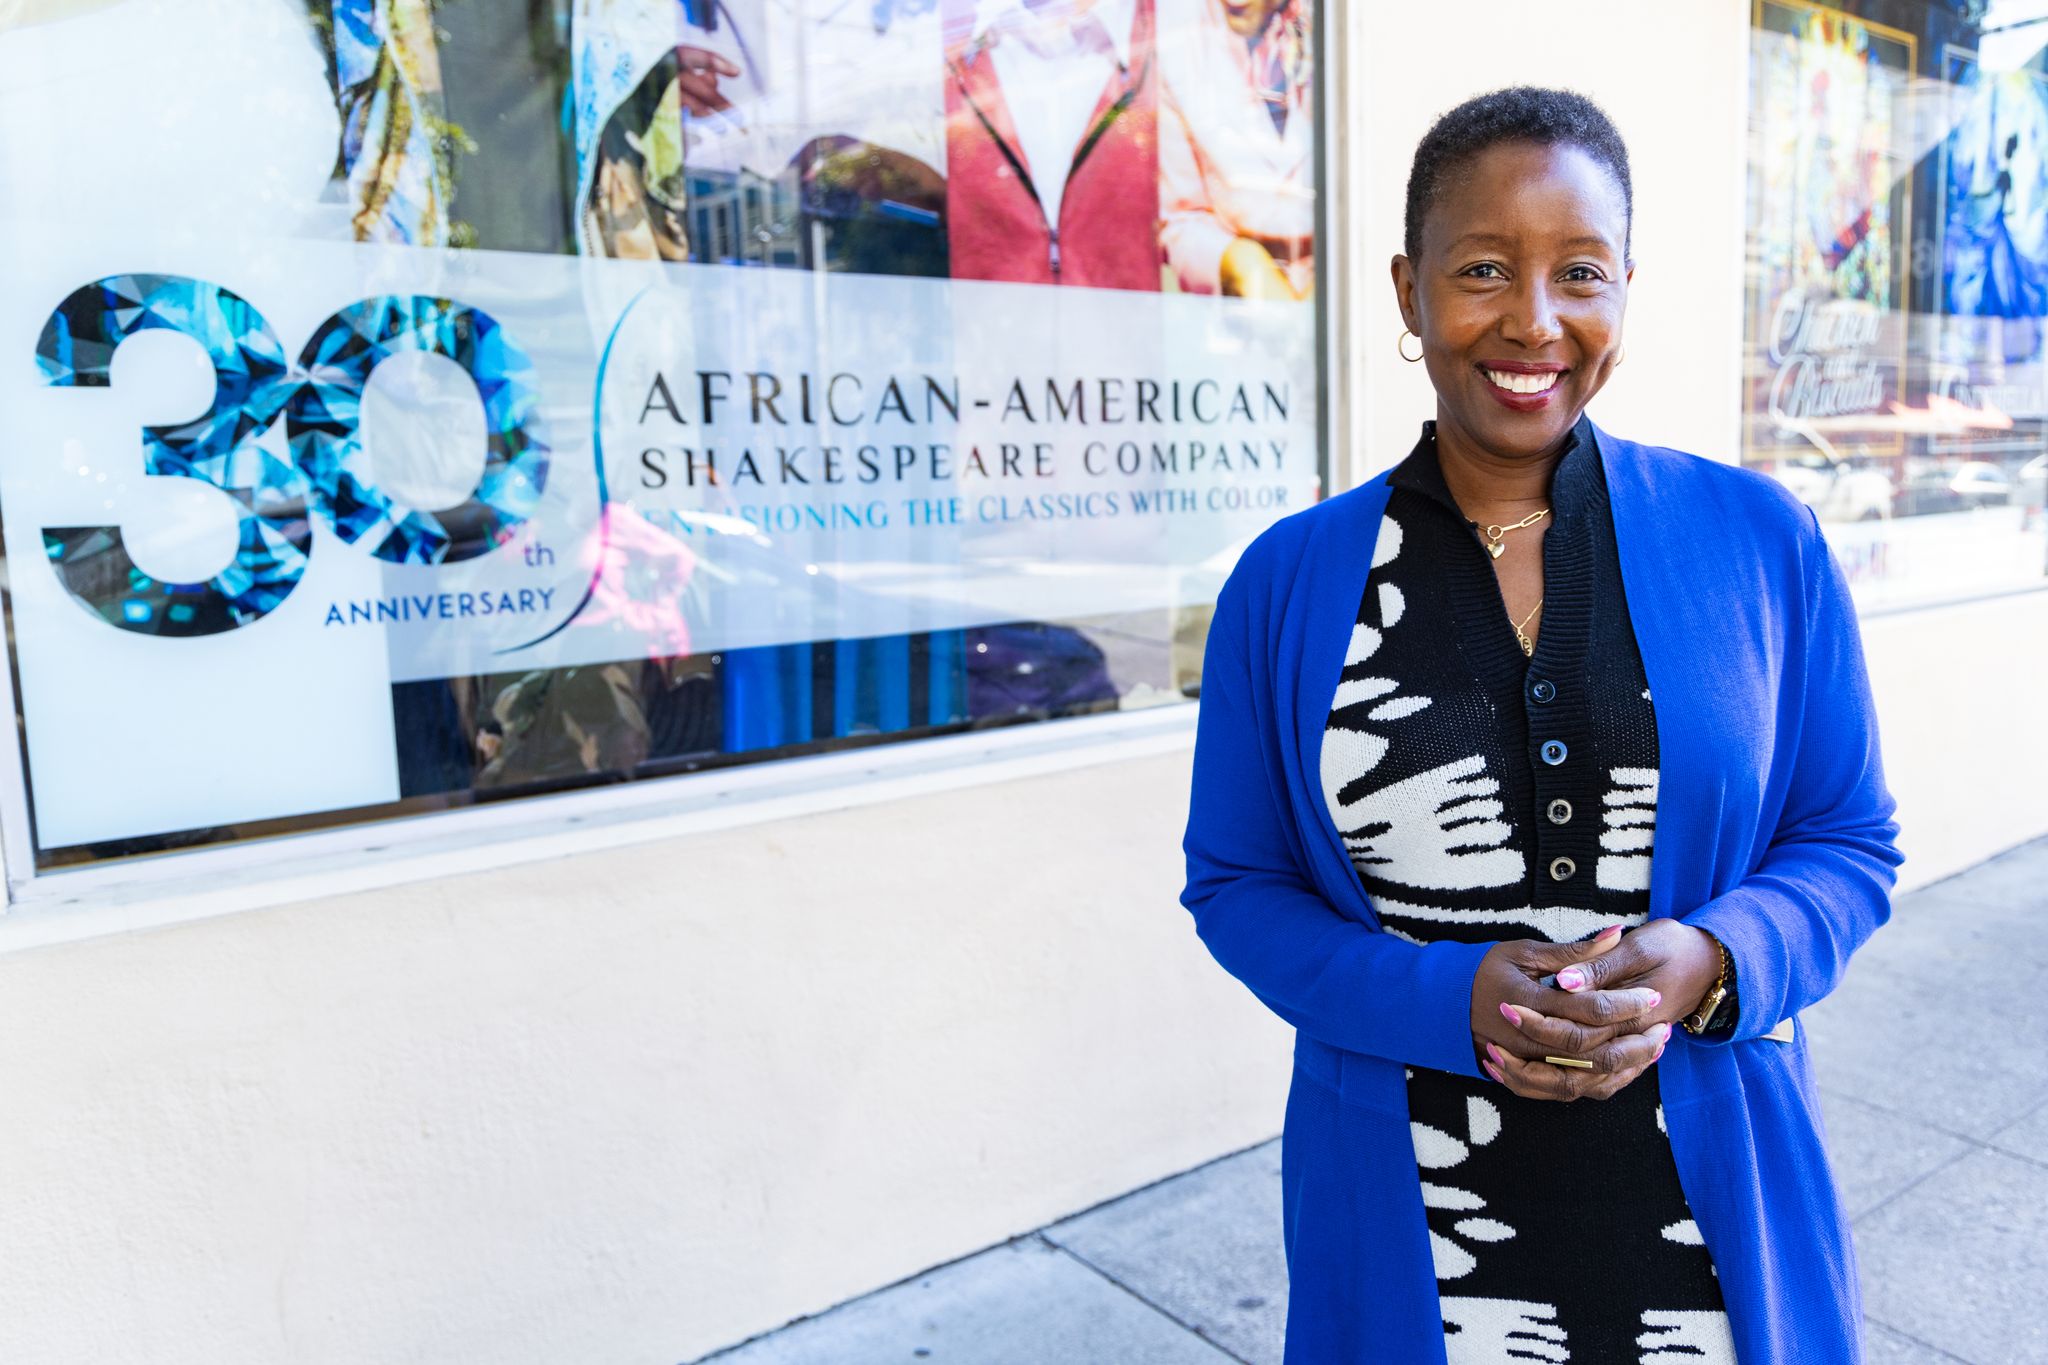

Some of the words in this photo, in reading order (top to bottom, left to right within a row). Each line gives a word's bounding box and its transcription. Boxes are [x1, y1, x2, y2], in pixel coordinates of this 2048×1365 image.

[639, 370, 1289, 426] AFRICAN-AMERICAN
[641, 441, 1055, 489] SHAKESPEARE
[1083, 439, 1288, 476] COMPANY
[642, 499, 888, 536] ENSIONING
[907, 497, 965, 527] THE
[978, 490, 1120, 525] CLASSICS
[1129, 487, 1198, 515] WITH
[1207, 485, 1289, 512] COLOR
[524, 541, 555, 568] th
[324, 587, 556, 627] ANNIVERSARY
